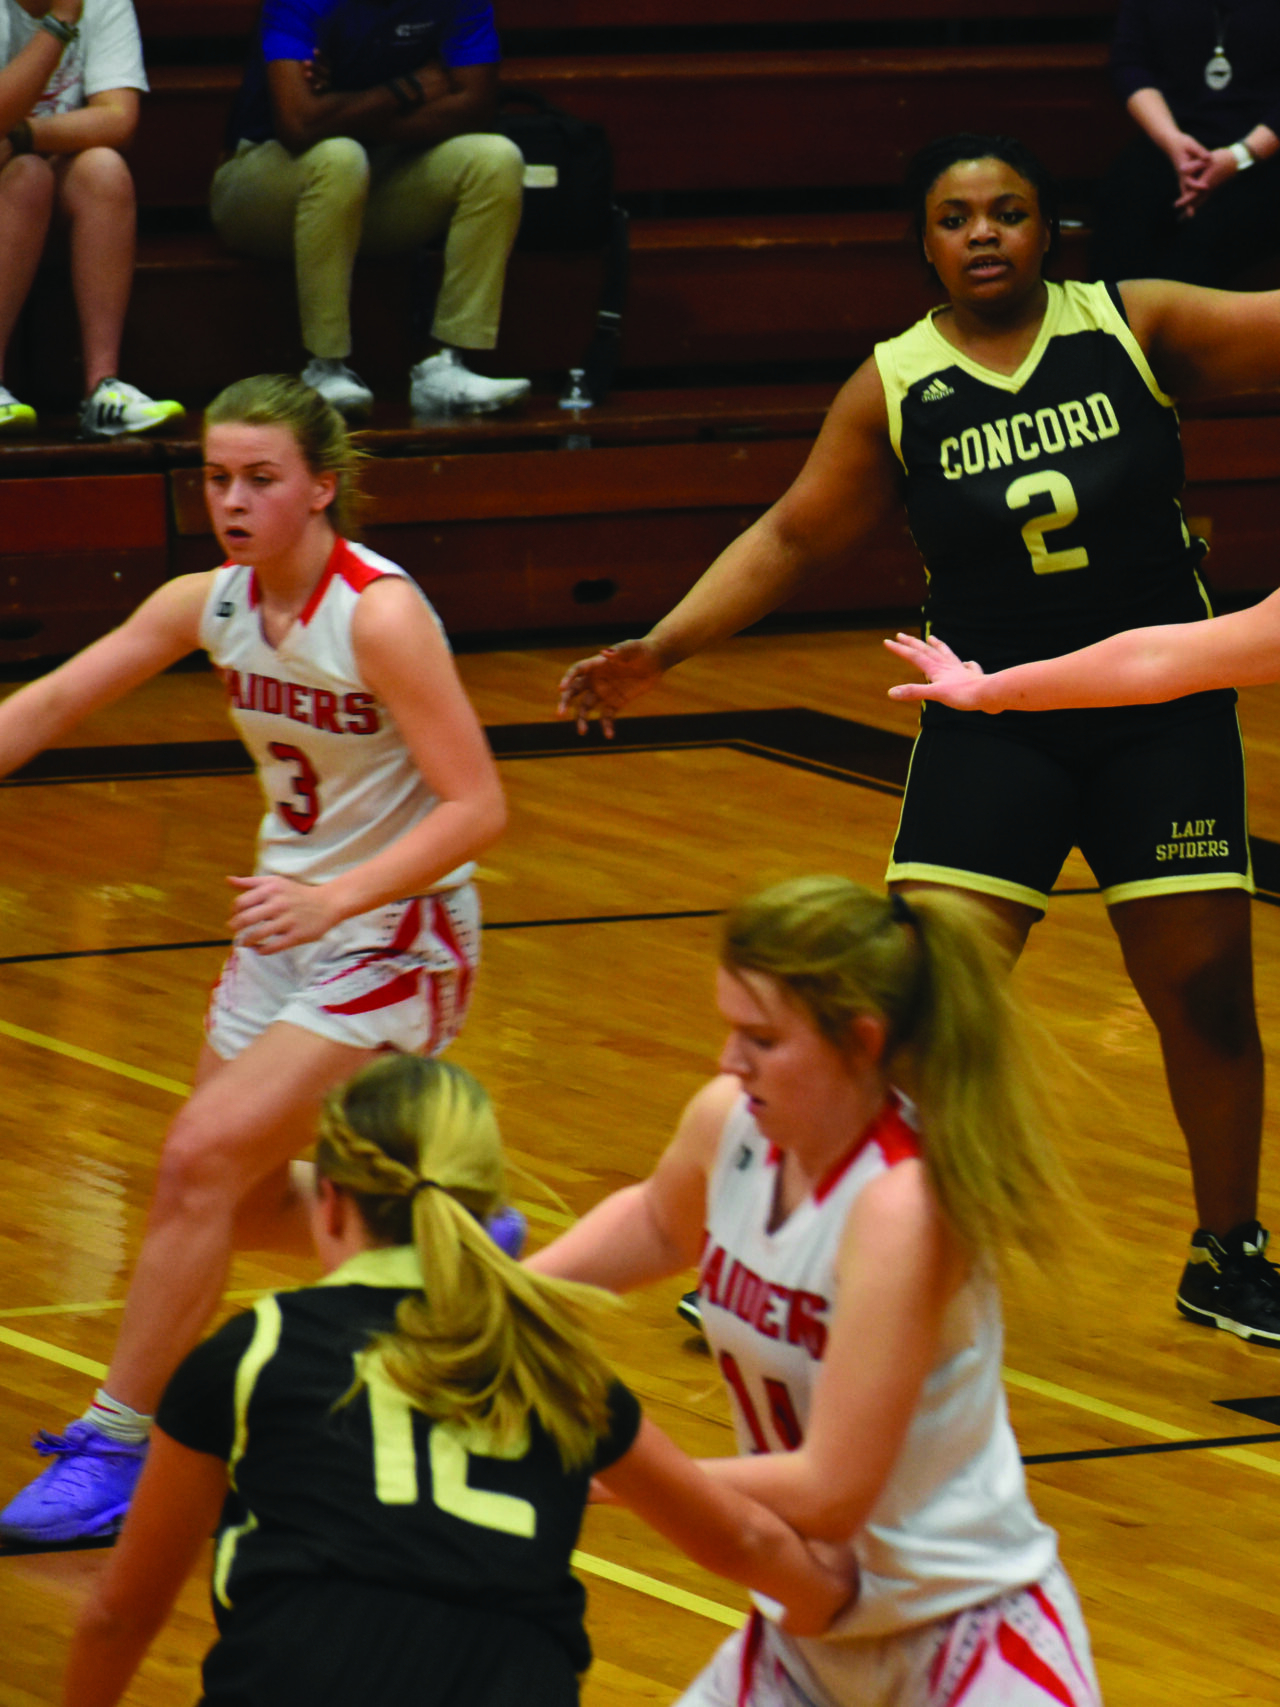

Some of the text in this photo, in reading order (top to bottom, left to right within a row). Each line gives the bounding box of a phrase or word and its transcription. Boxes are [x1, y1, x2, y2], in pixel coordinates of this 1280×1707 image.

[940, 392, 1120, 480] CONCORD
[1005, 470, 1089, 575] 2
[226, 667, 381, 735] AIDERS
[267, 741, 320, 835] 3
[1171, 819, 1216, 839] LADY
[1155, 840, 1229, 862] SPIDERS
[352, 1350, 537, 1539] 12
